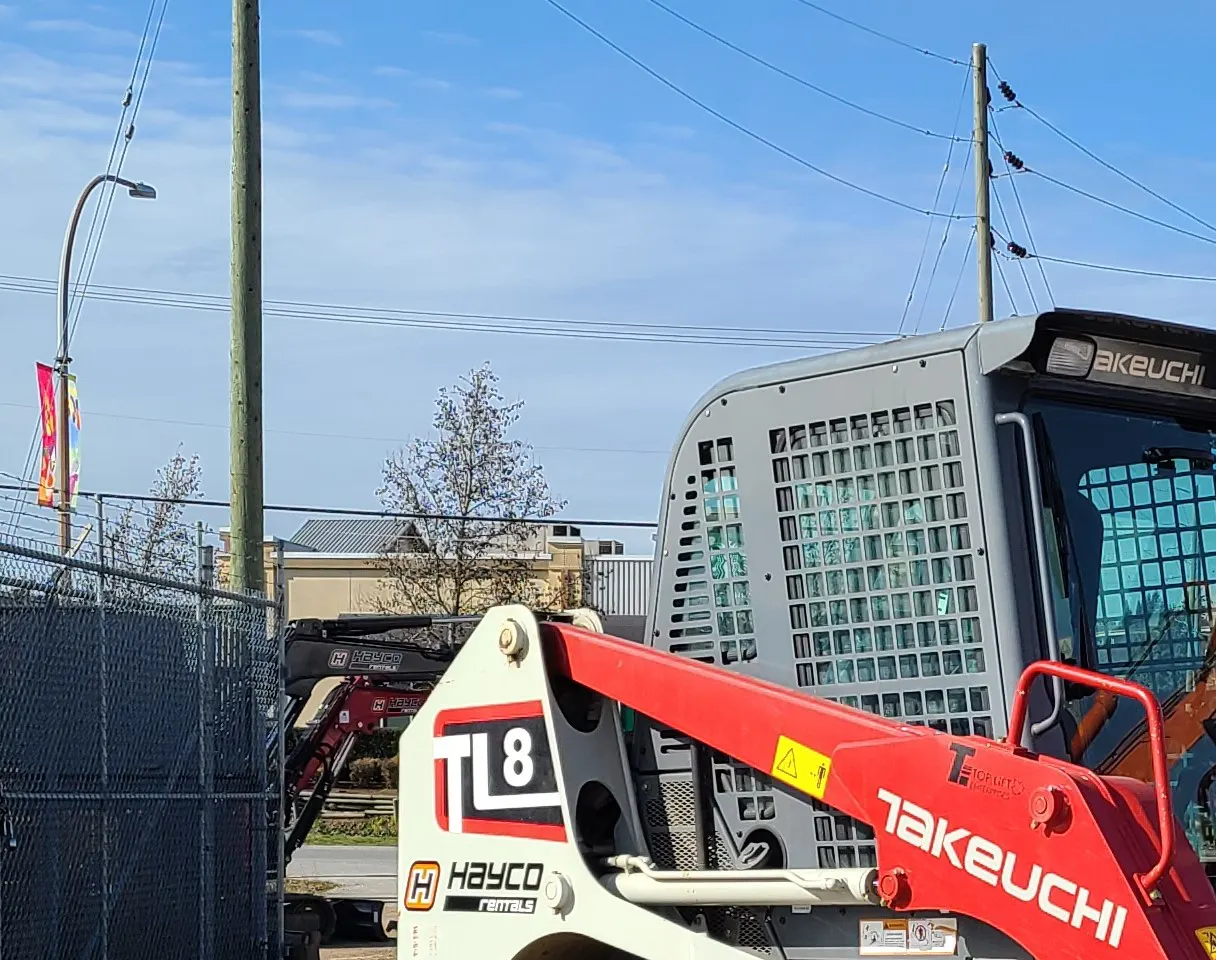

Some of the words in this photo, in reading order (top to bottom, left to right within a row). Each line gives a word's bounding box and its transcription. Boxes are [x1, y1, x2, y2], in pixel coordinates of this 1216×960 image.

[1093, 349, 1206, 386] AKEUCHI
[389, 697, 420, 708] HAYC
[432, 726, 562, 834] TL8
[447, 861, 544, 891] HAYCO
[877, 787, 1128, 948] TAKEUCHI
[478, 898, 535, 913] rentals
